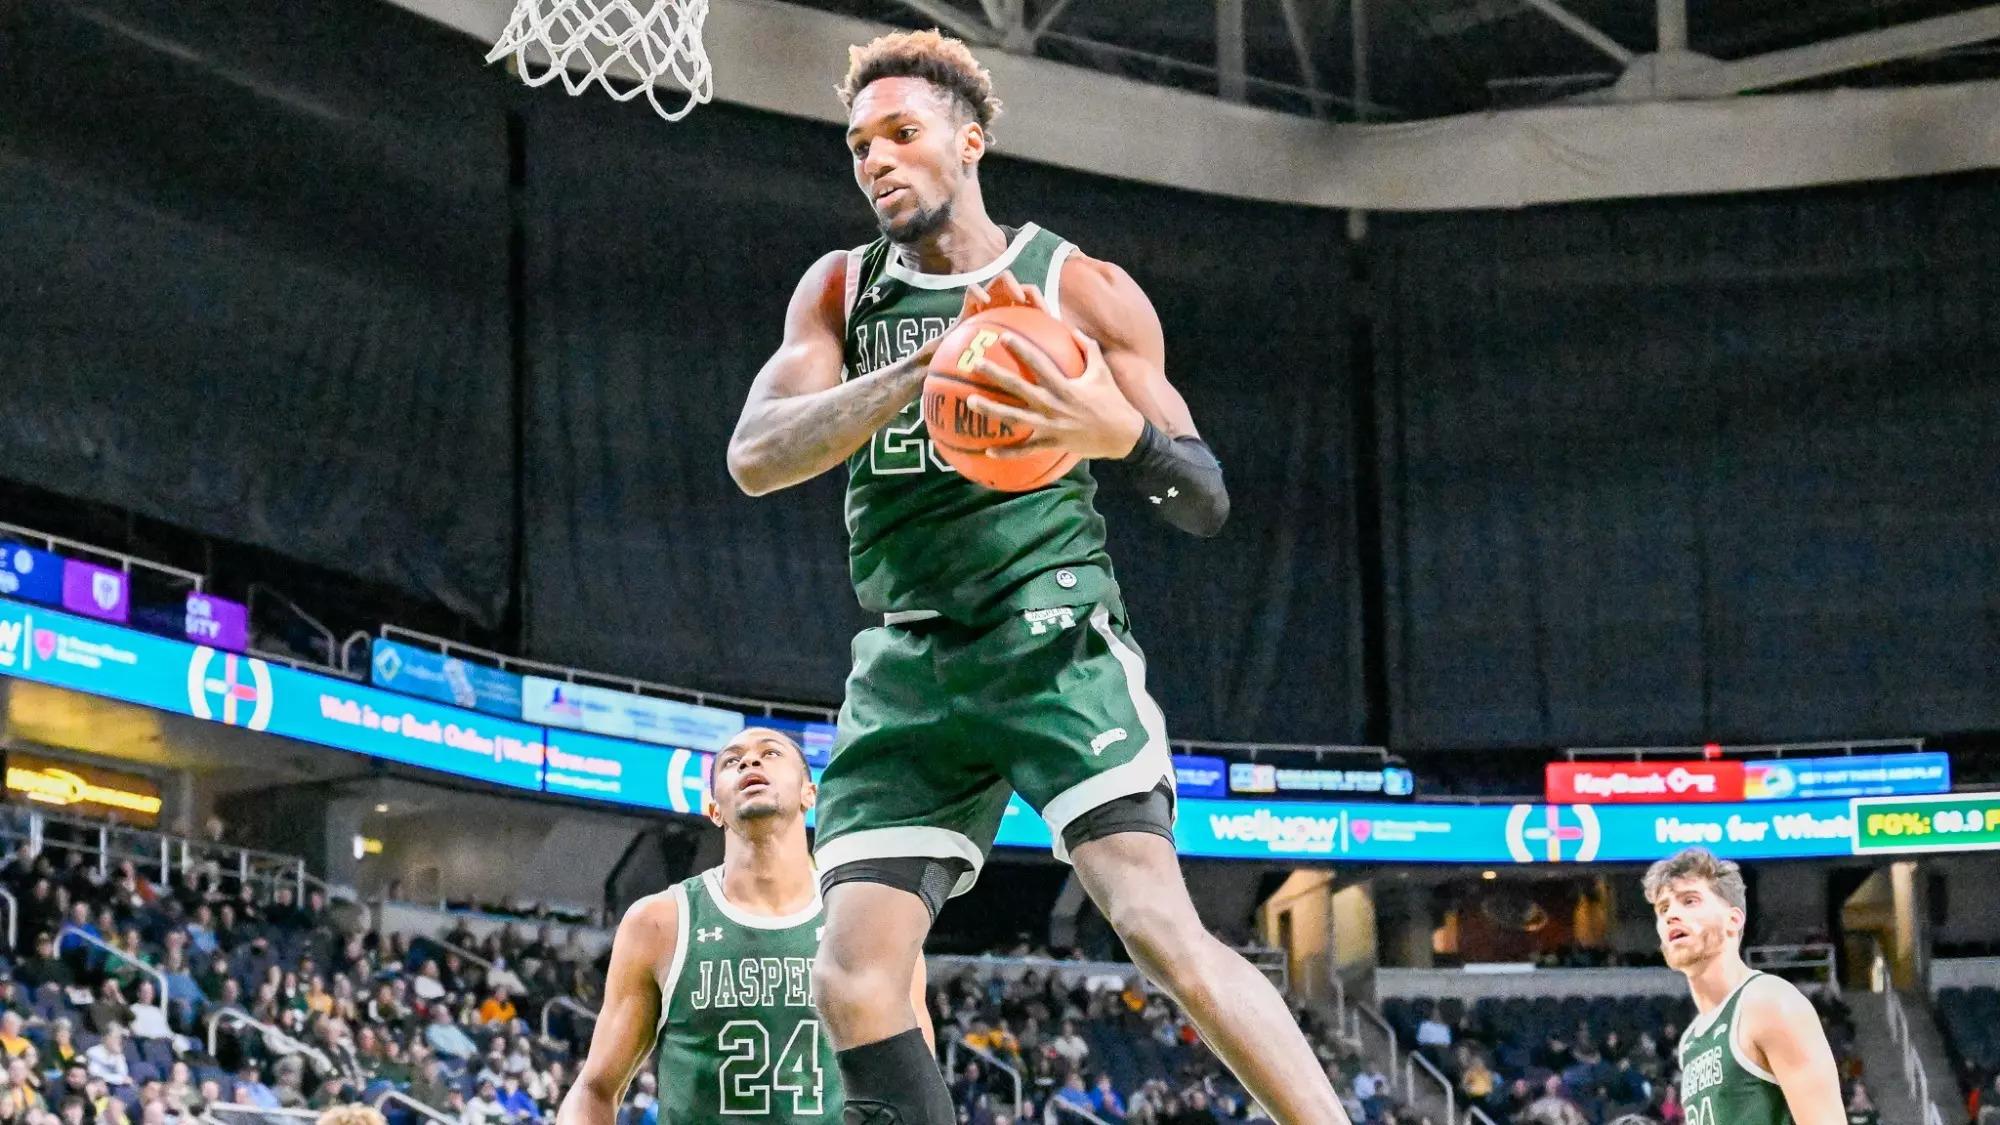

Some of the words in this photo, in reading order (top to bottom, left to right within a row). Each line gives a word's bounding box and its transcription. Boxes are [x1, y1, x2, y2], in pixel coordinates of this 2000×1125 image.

[855, 317, 957, 377] JASP
[871, 401, 957, 475] 2
[718, 1019, 823, 1114] 24
